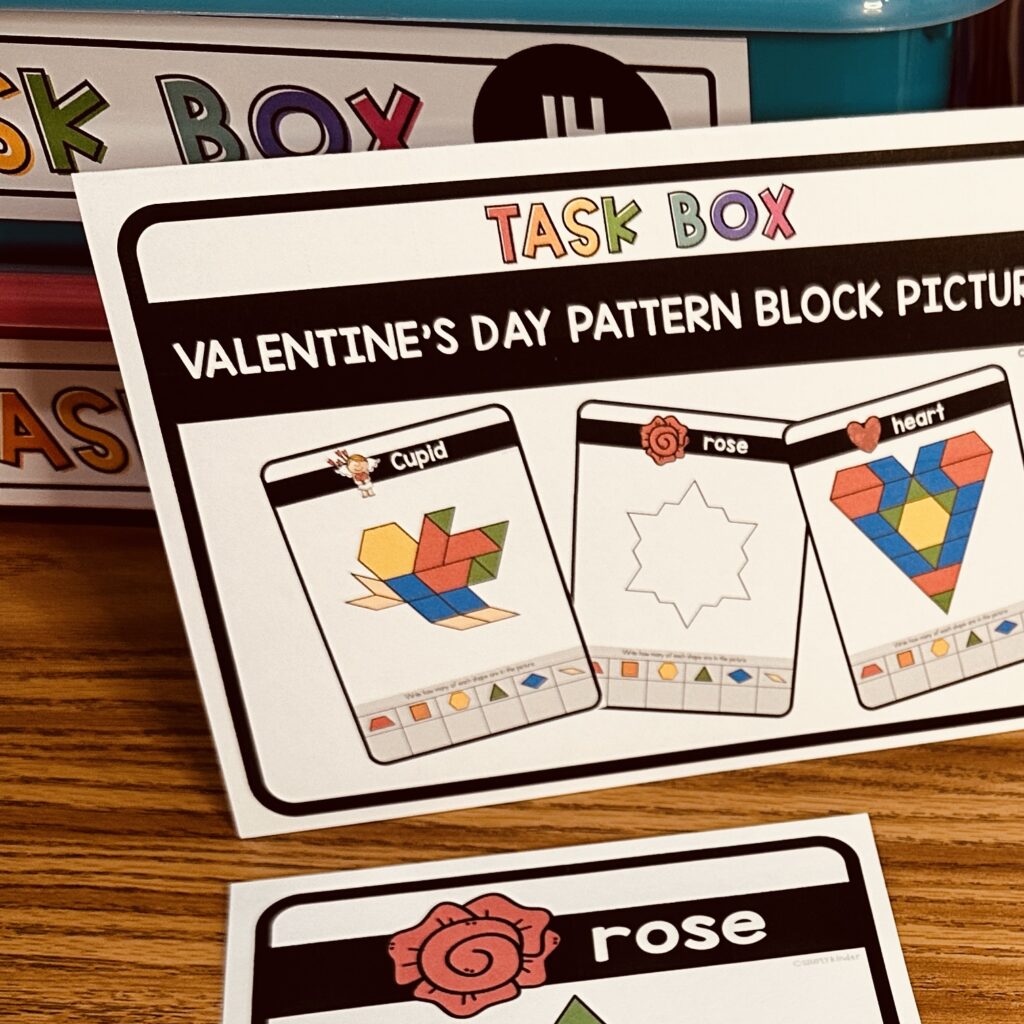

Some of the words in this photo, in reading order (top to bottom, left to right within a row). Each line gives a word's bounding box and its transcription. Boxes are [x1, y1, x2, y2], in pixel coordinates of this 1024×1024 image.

[155, 74, 423, 166] BOX
[485, 195, 642, 264] TASK
[667, 183, 796, 249] BOX
[172, 317, 459, 380] VALENTINE'S
[470, 308, 551, 352] DAY
[566, 289, 742, 344] PATTERN
[755, 282, 884, 328] BLOCK
[702, 435, 748, 455] rose
[891, 402, 945, 435] heart
[390, 440, 449, 472] Cupid
[592, 910, 767, 963] rose
